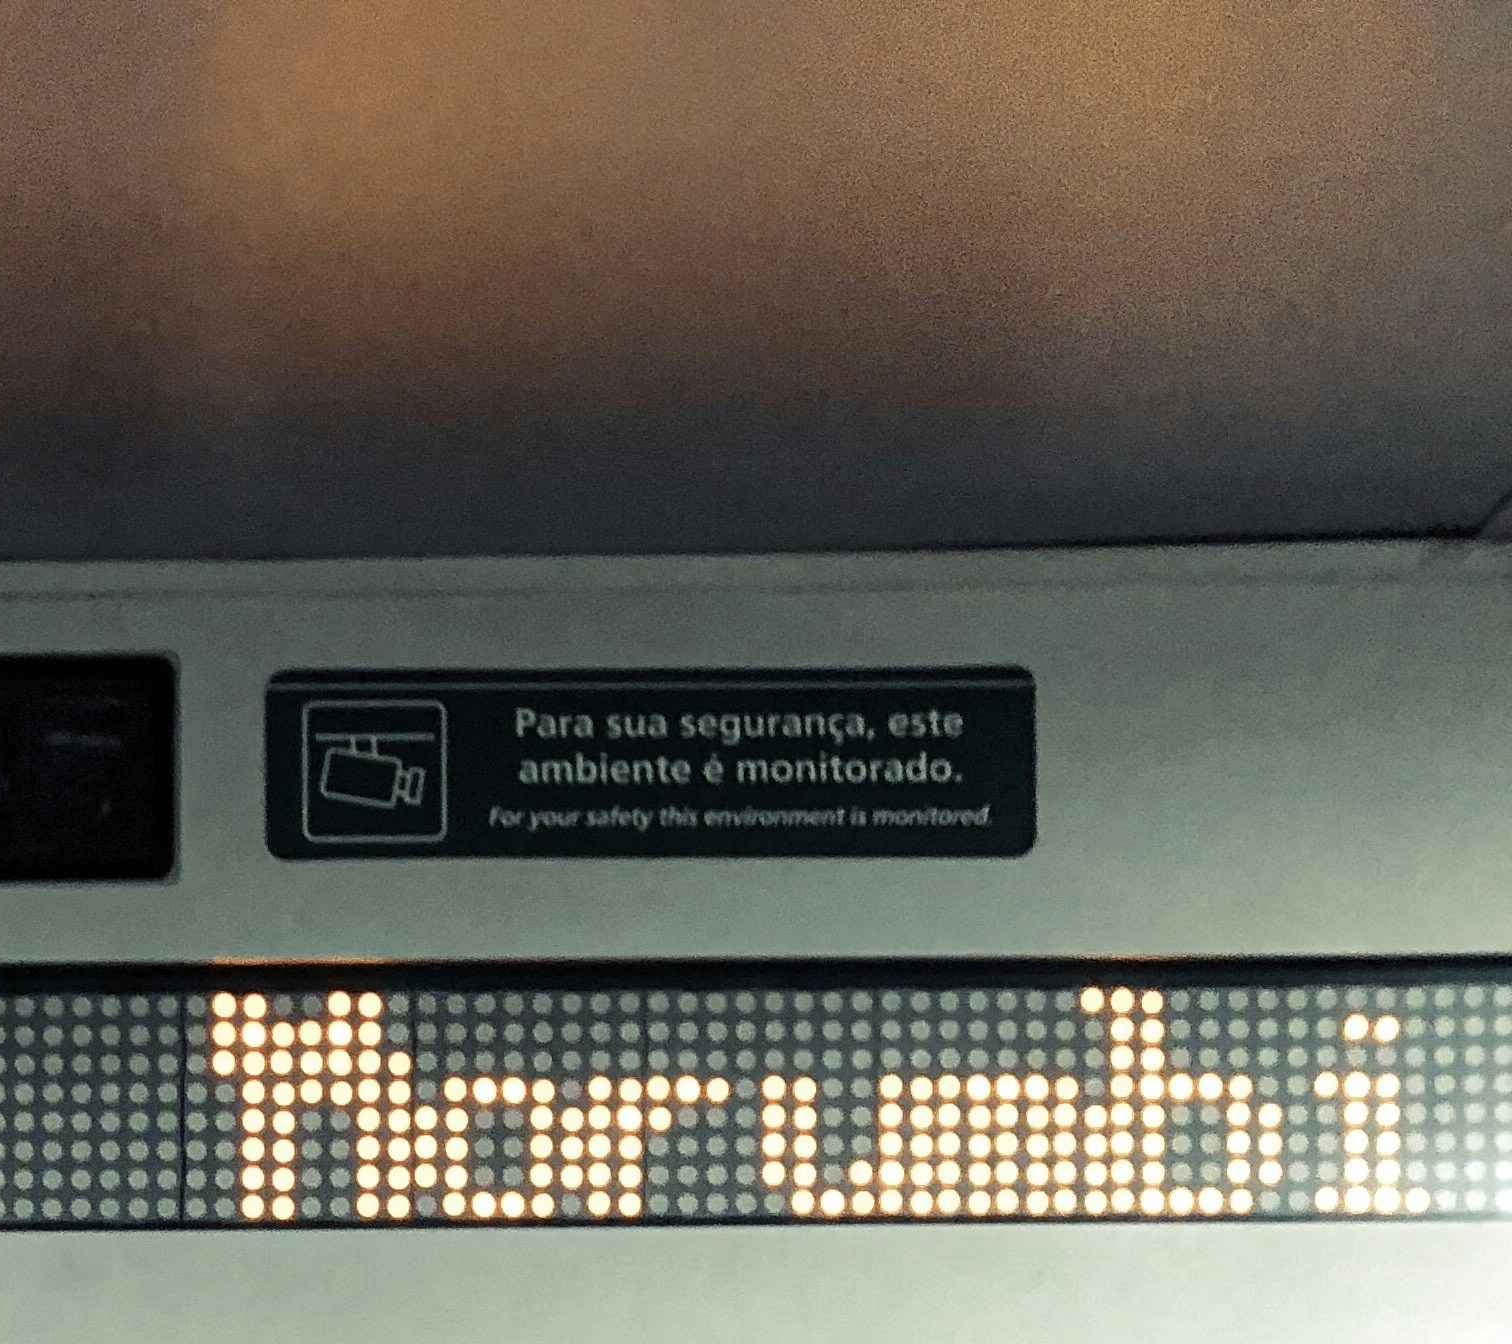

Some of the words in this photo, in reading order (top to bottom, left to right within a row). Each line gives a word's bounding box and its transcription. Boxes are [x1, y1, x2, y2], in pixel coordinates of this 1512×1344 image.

[515, 707, 594, 738] Para
[606, 713, 668, 738] sua
[680, 712, 876, 746] segurança,
[887, 709, 965, 738] este
[518, 751, 691, 784] ambiente
[701, 753, 724, 784] é
[736, 750, 963, 784] monitorado.
[488, 805, 522, 827] For
[530, 810, 578, 832] your
[586, 806, 651, 832] safety
[658, 804, 697, 827] this
[702, 805, 845, 827] environment
[850, 806, 867, 826] is
[211, 987, 1432, 1222] Morumbi
